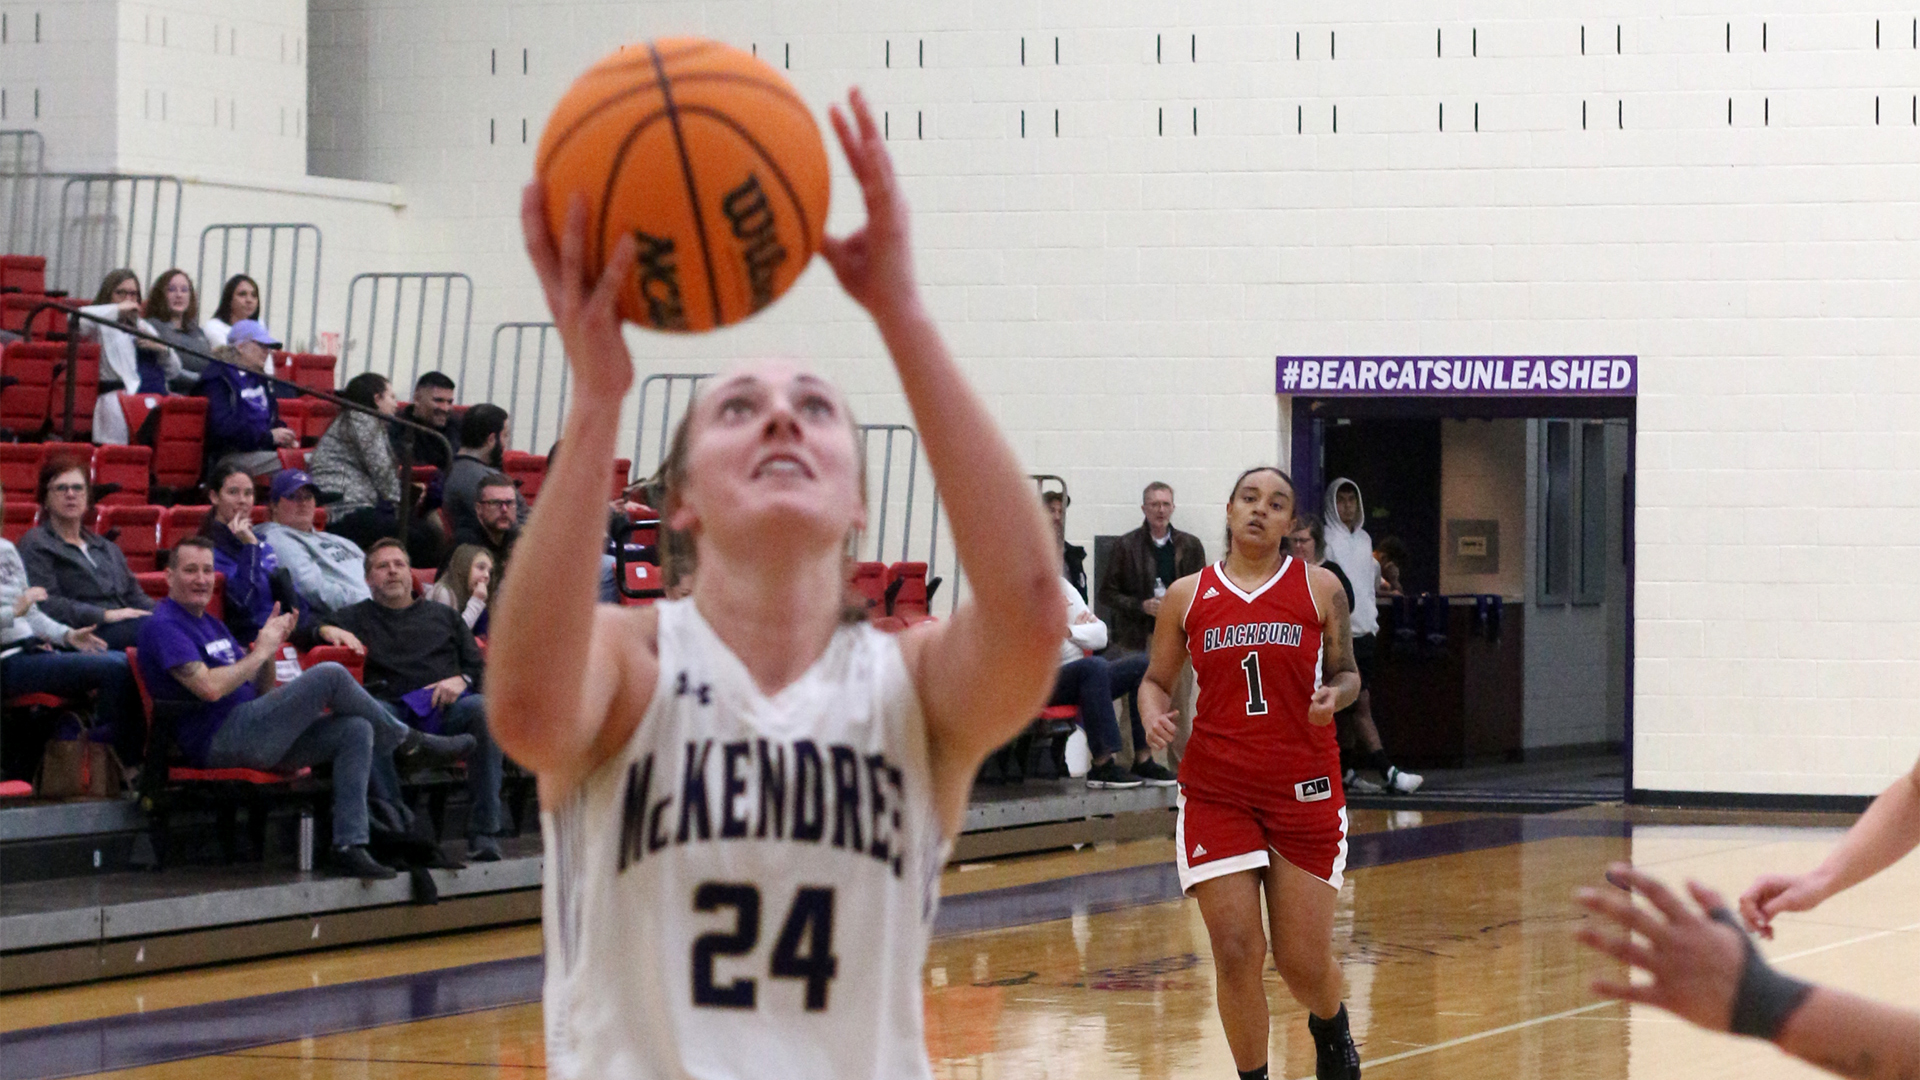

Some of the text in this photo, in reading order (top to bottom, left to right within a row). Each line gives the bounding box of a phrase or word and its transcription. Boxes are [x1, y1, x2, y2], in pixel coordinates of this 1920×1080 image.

[1282, 360, 1632, 390] #BEARCATSUNLEASHED
[1204, 623, 1303, 653] BLACKBURN
[1241, 651, 1268, 716] 1
[692, 882, 837, 1011] 24
